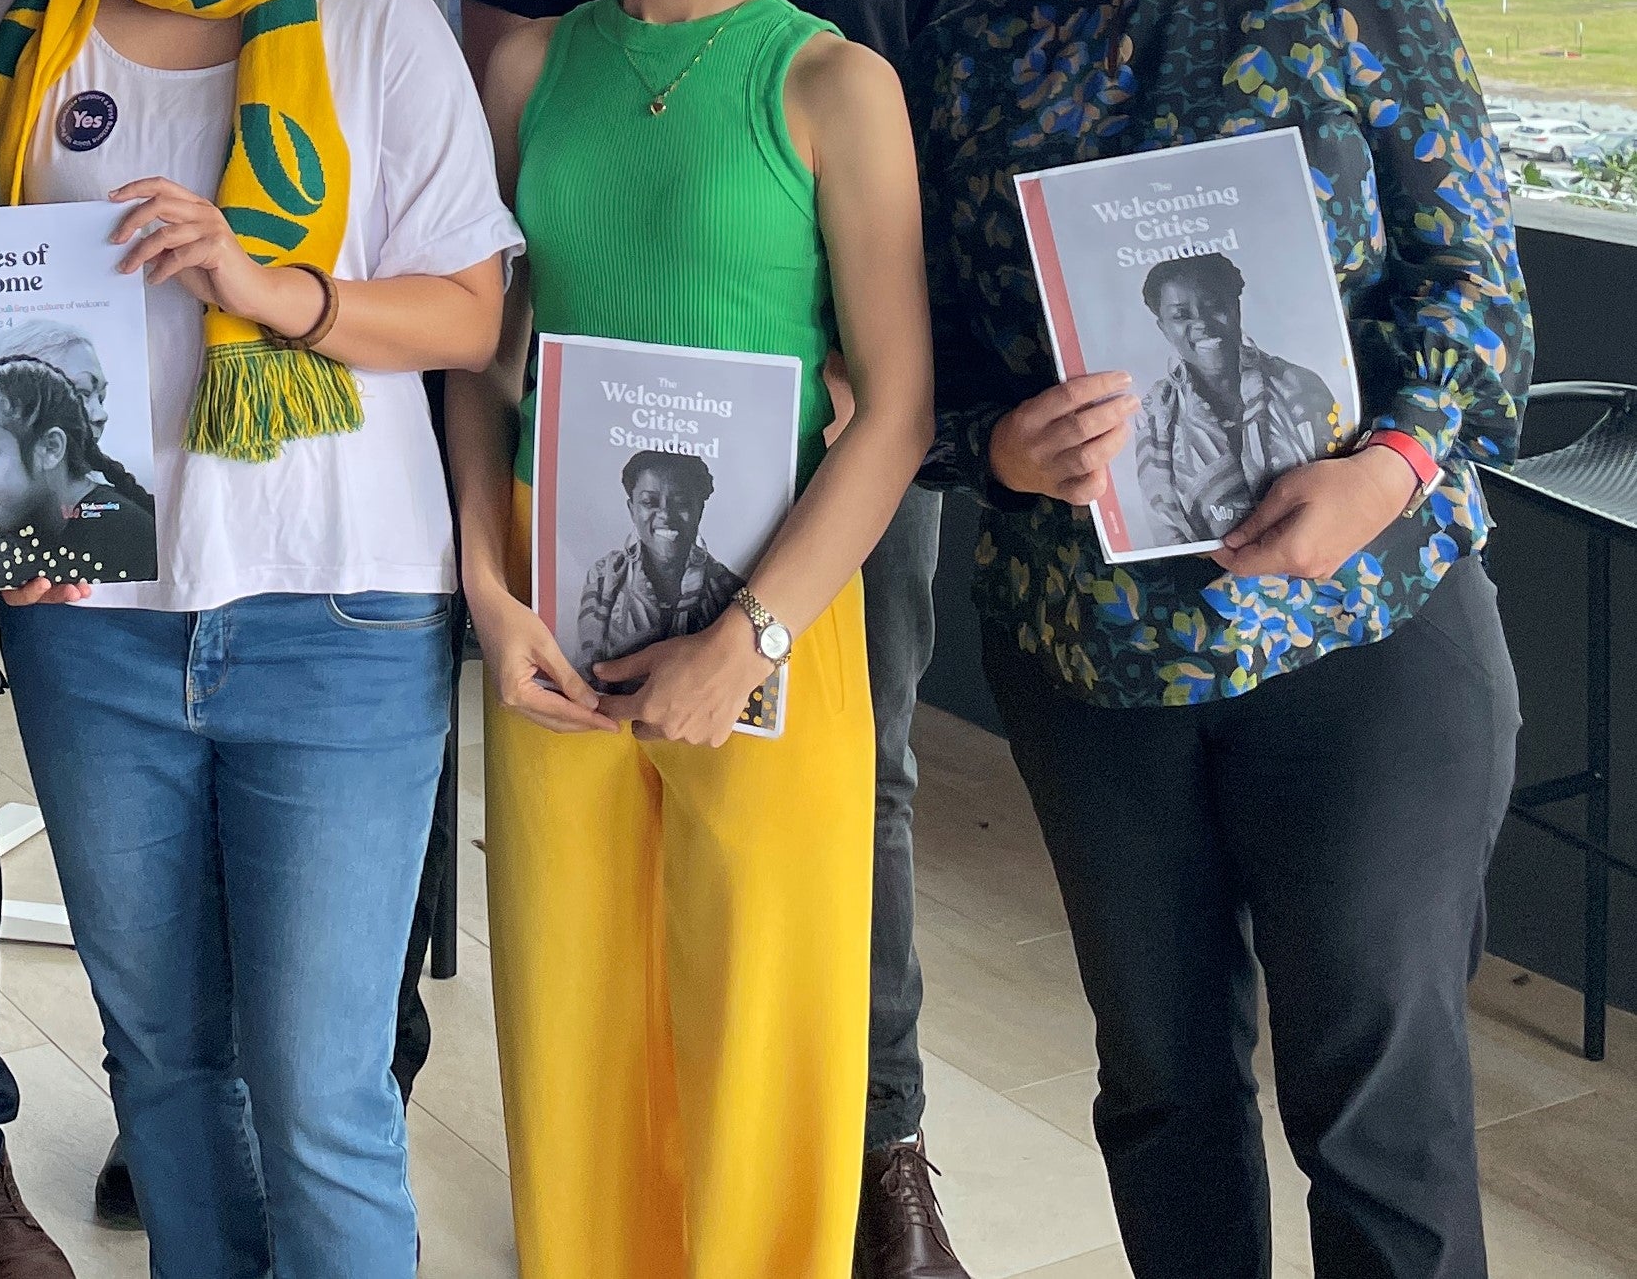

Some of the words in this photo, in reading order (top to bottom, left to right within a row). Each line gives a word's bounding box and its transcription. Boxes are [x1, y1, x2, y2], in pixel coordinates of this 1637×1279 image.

[72, 110, 103, 129] Yes
[1091, 185, 1240, 223] Welcoming
[1134, 214, 1210, 242] Cities
[22, 242, 50, 266] of
[1116, 228, 1239, 268] Standard
[65, 300, 75, 310] of
[75, 299, 111, 309] welcome
[5, 317, 13, 328] 4
[659, 377, 678, 389] The
[600, 380, 733, 418] Welcoming
[631, 408, 699, 434] Cities
[609, 426, 720, 458] Standard
